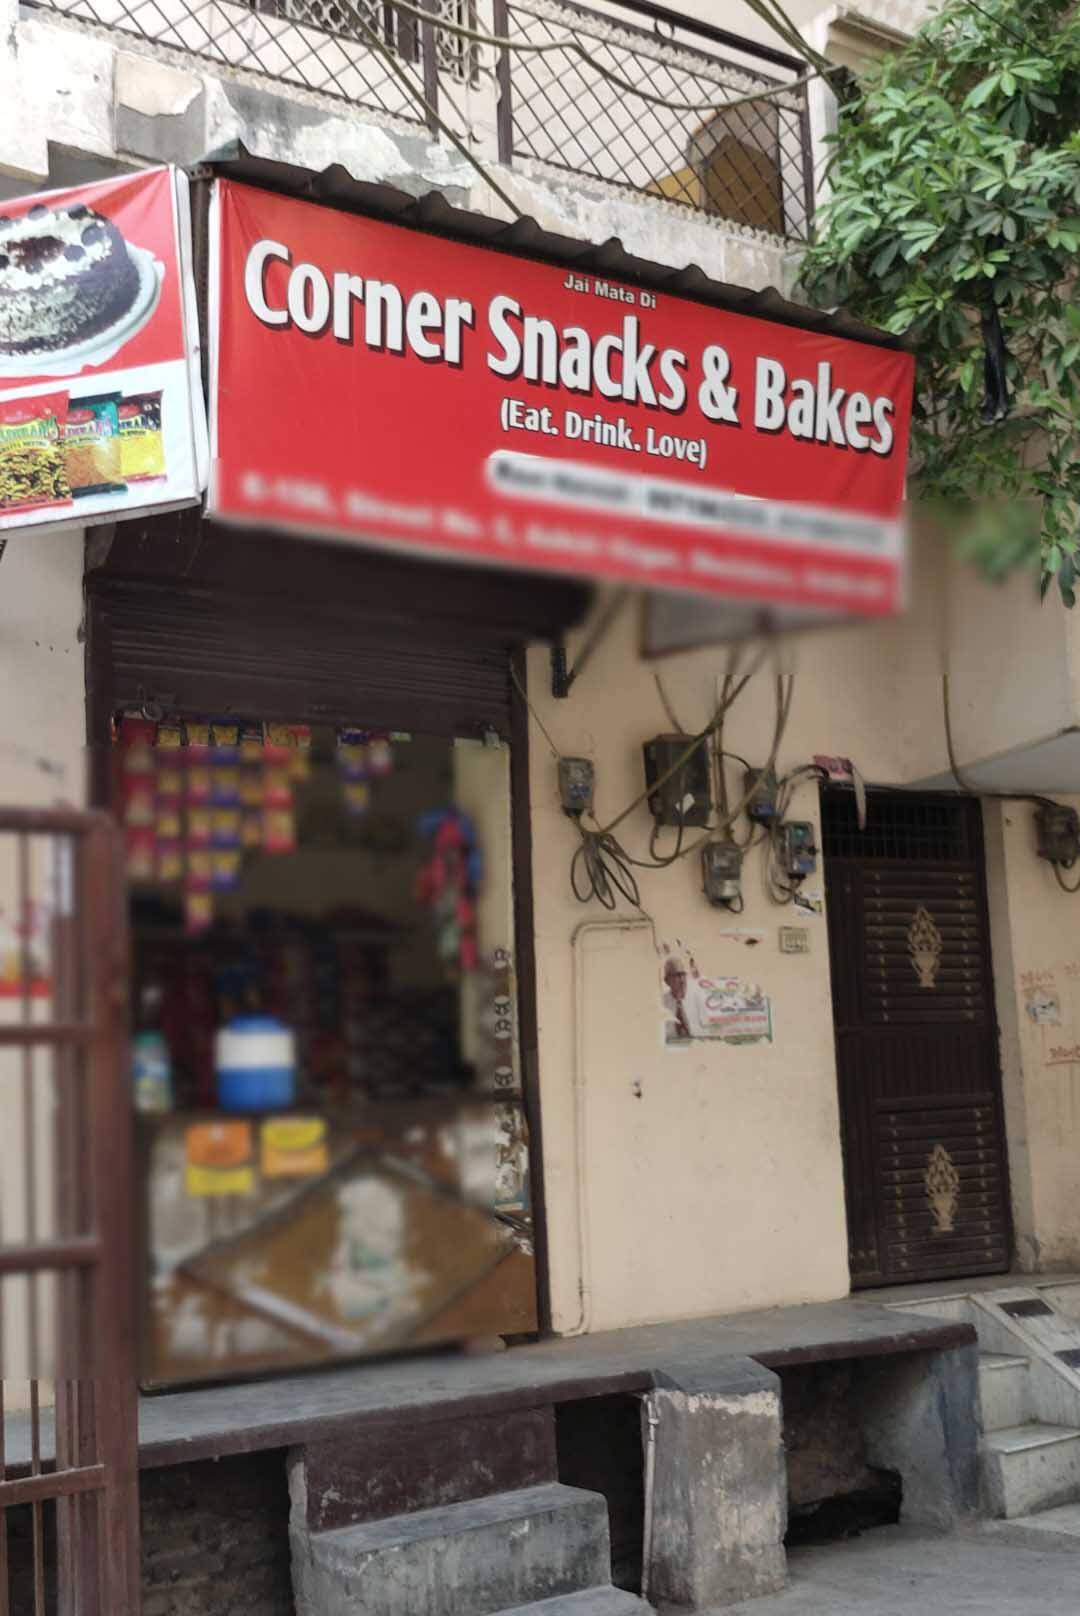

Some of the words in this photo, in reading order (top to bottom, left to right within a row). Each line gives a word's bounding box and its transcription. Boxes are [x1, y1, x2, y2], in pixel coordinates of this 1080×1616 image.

[563, 274, 590, 292] Jai
[594, 279, 636, 303] Mata
[640, 292, 657, 309] Di
[244, 239, 474, 364] Corner
[486, 295, 687, 412] Snacks
[698, 344, 739, 424] &
[754, 356, 894, 455] Bakes
[500, 398, 559, 435] (Eat.
[565, 410, 641, 452] Drink.
[647, 428, 707, 469] Love)
